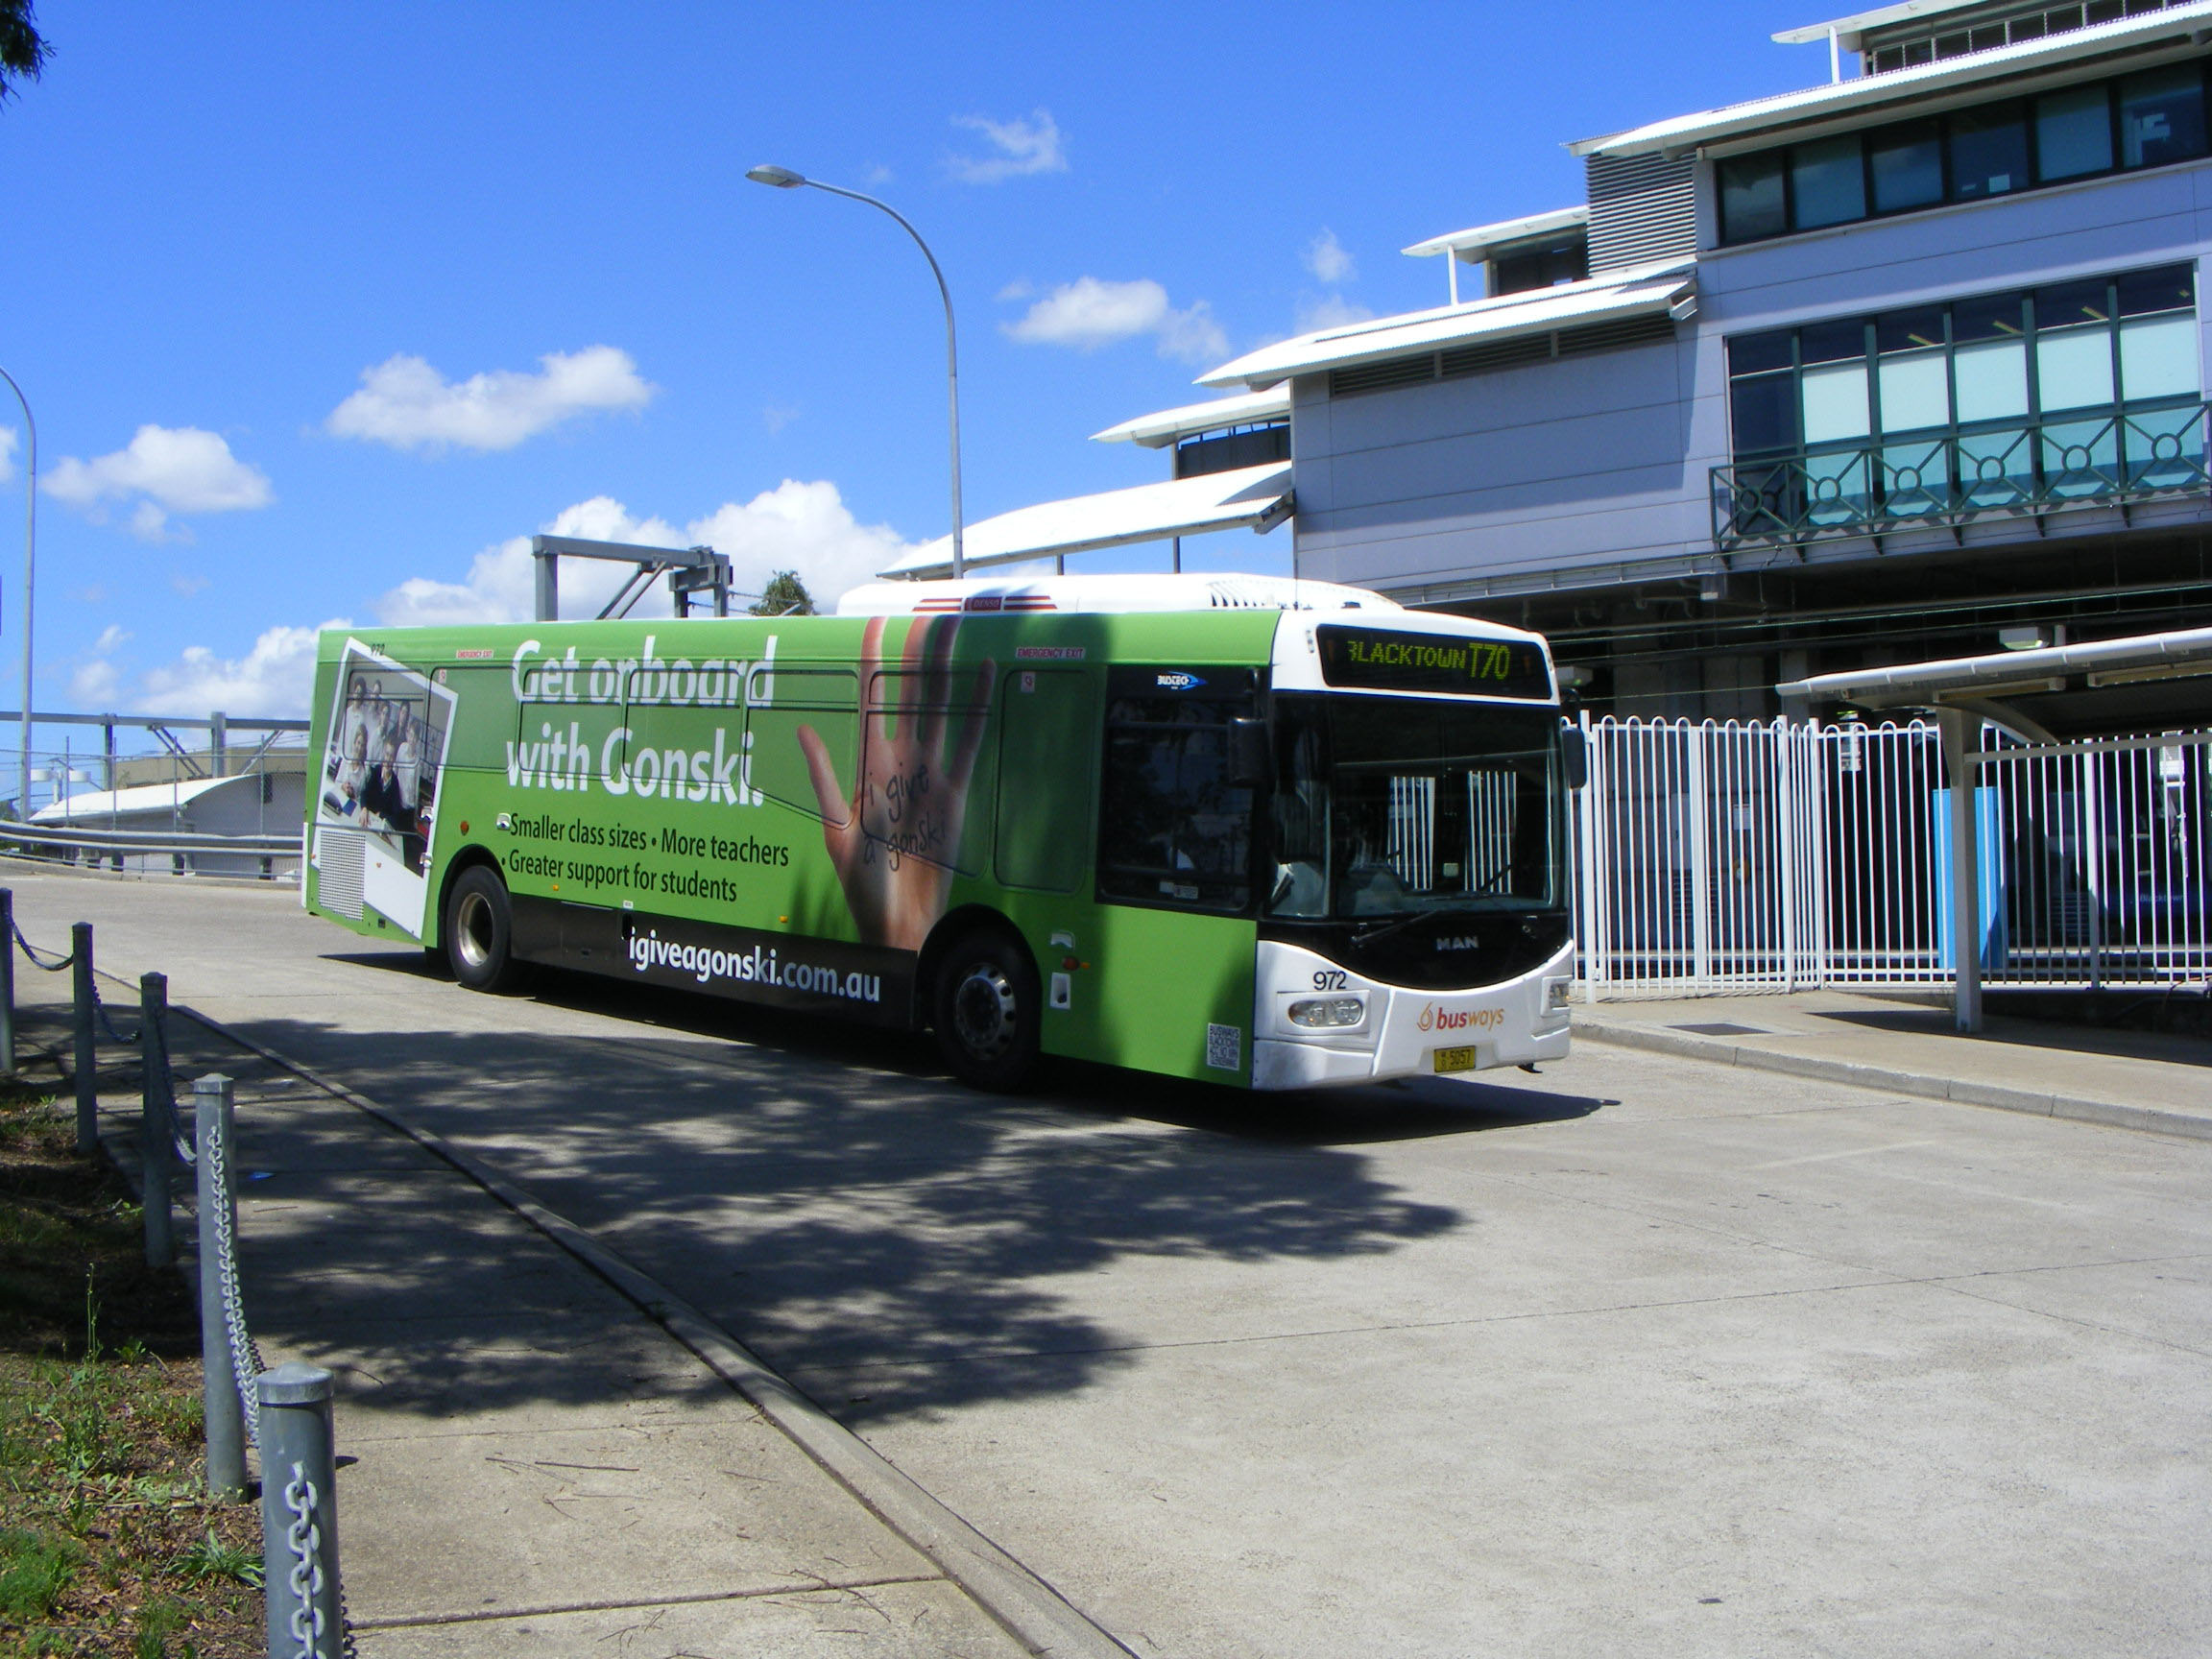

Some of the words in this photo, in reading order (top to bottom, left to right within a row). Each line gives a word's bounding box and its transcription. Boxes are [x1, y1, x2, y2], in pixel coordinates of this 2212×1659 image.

[512, 639, 580, 703] Get
[1018, 649, 1063, 659] EMERGENCY
[1066, 648, 1084, 659] EXIT
[1469, 642, 1510, 680] T70
[507, 722, 590, 792] with
[600, 727, 764, 807] Gonski.
[886, 761, 929, 823] give
[510, 813, 565, 841] Smaller
[568, 818, 605, 847] class
[609, 823, 647, 851] sizes
[661, 828, 706, 857] More
[710, 835, 789, 867] teachers
[509, 850, 564, 878] Greater
[566, 855, 629, 890] support
[634, 862, 657, 891] for
[661, 869, 737, 902] students
[629, 926, 880, 1002] igiveagonski.com.au
[1436, 936, 1479, 950] MAN
[1312, 971, 1347, 991] 972
[1436, 1006, 1504, 1031] busways
